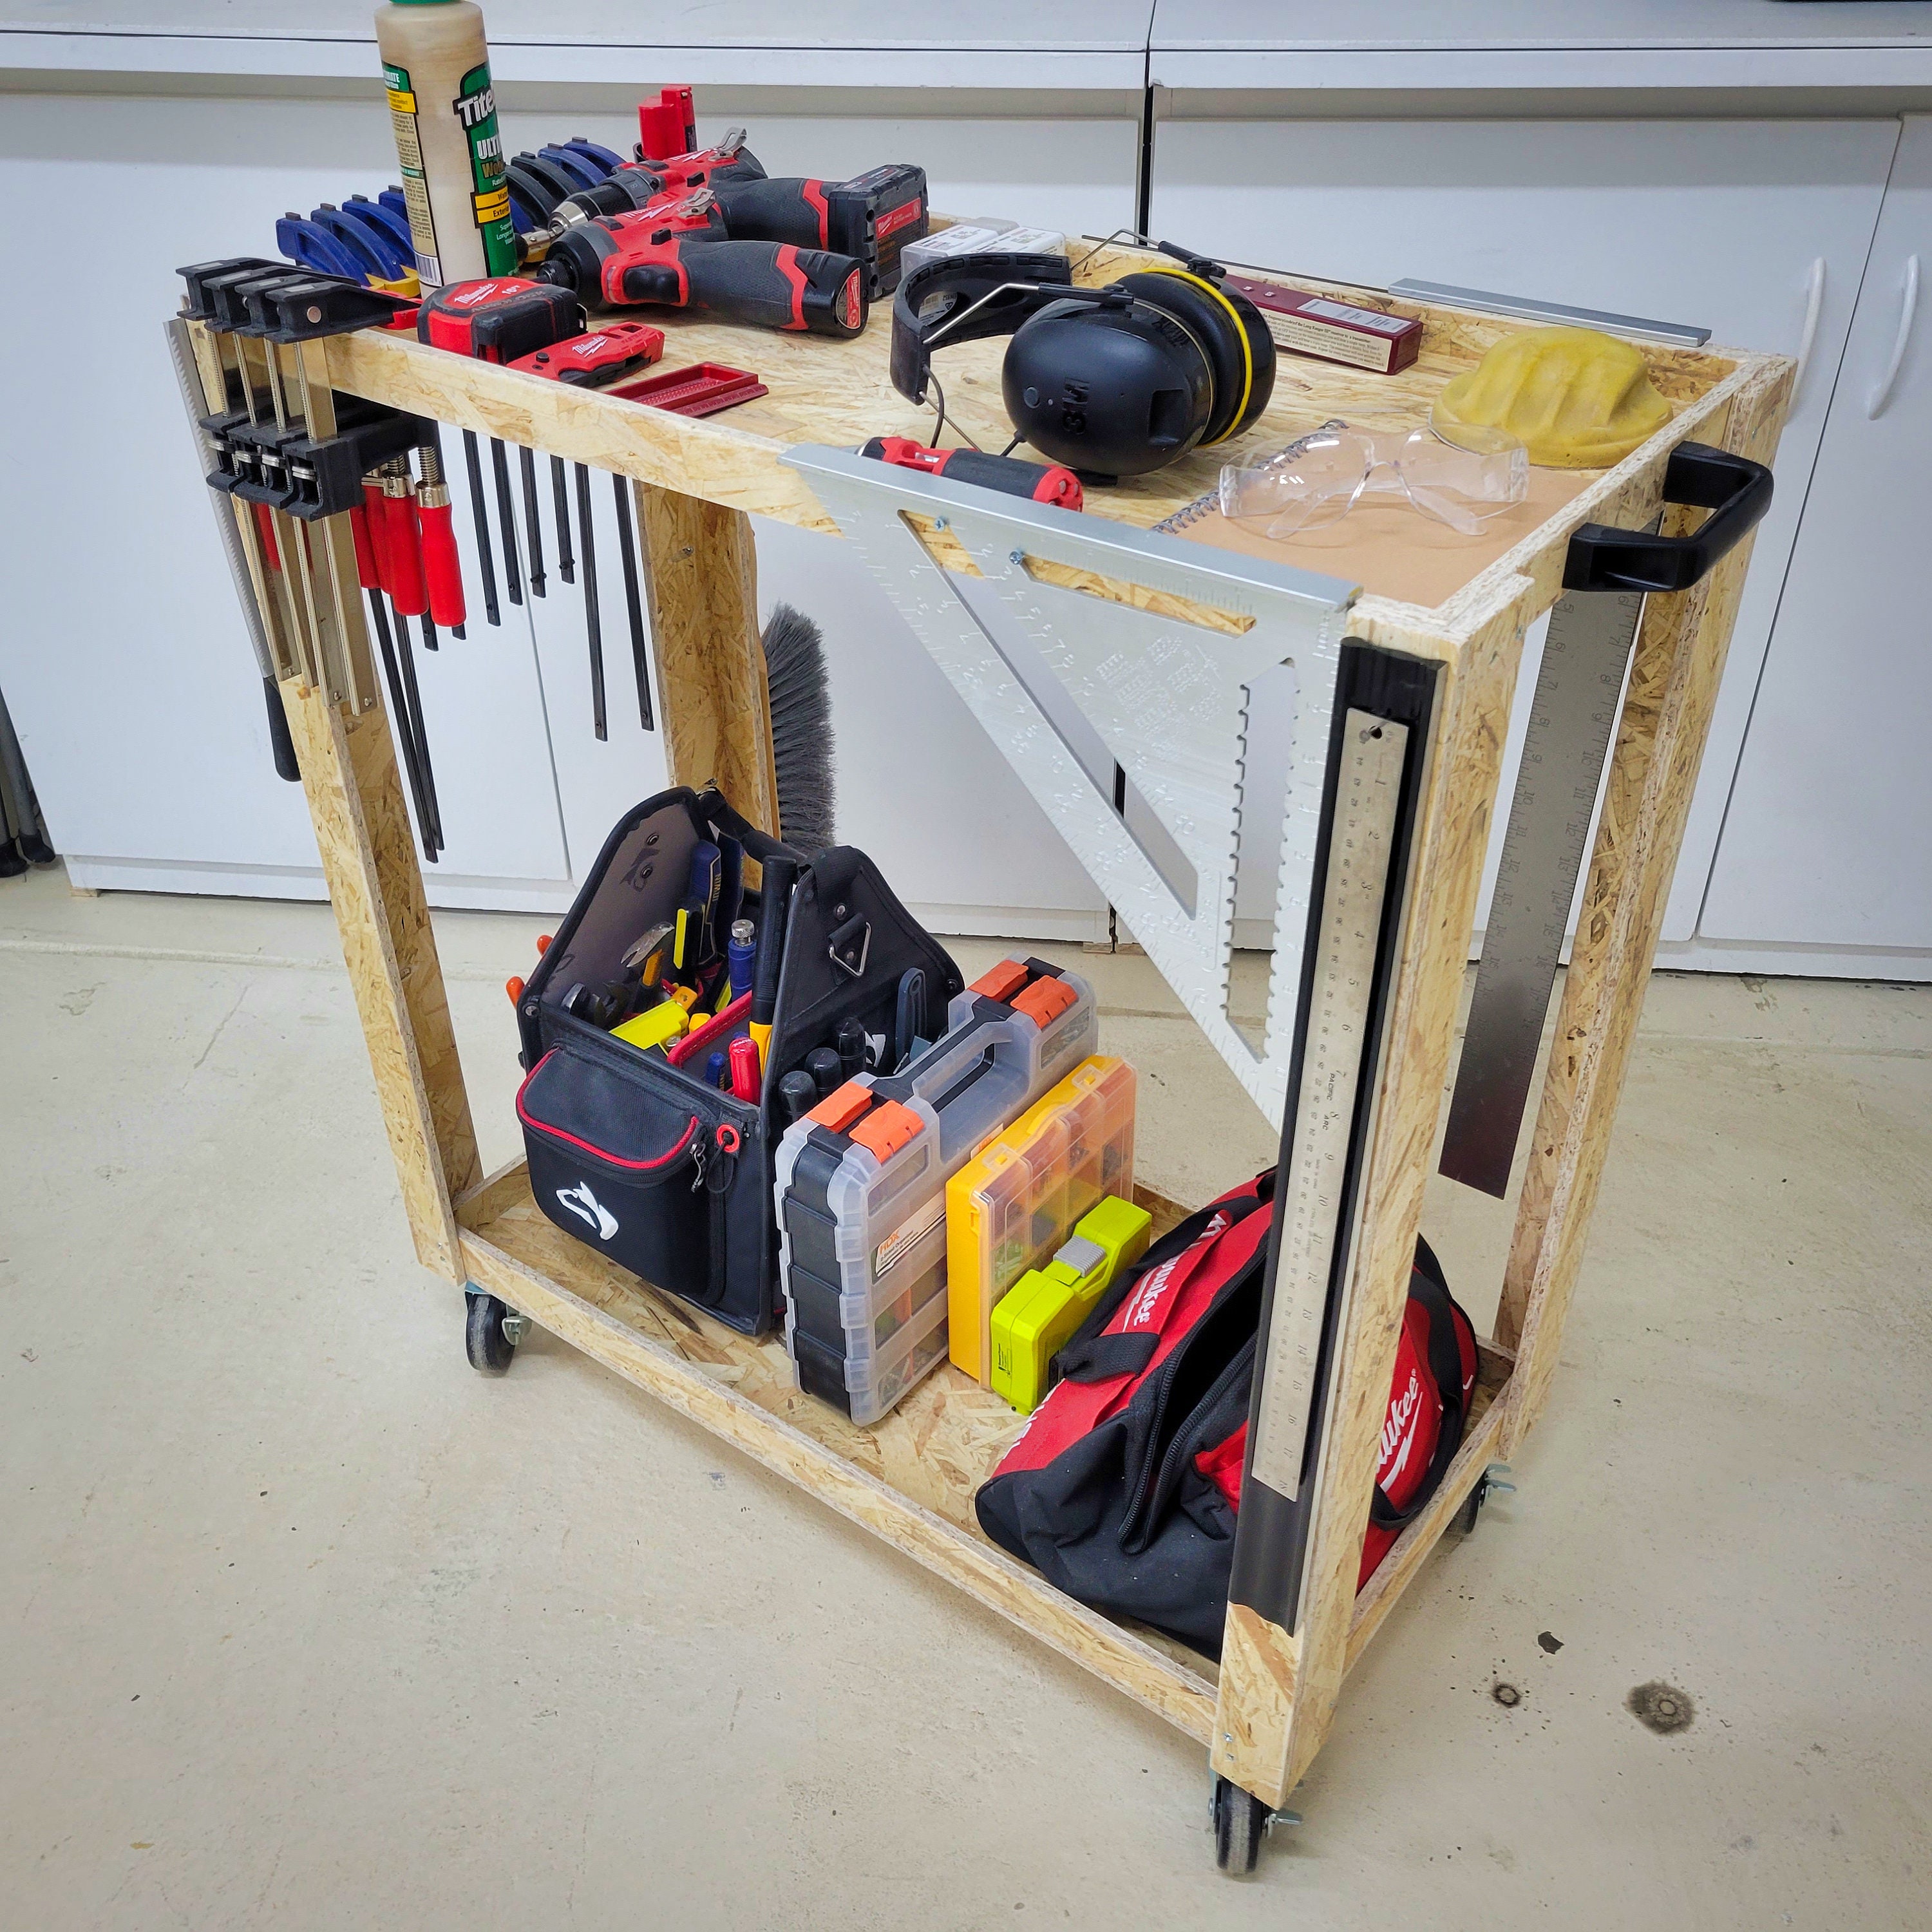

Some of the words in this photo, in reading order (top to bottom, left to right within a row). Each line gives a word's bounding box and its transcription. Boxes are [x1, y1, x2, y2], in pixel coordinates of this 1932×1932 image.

[458, 89, 495, 126] Tite
[454, 283, 495, 304] Milwaukee
[572, 336, 606, 355] Milwaukee
[1564, 603, 1575, 612] 5
[1555, 642, 1566, 650] 6
[1611, 636, 1621, 645] 7
[1600, 674, 1611, 683] 8
[1549, 681, 1558, 690] 7
[1531, 753, 1542, 762] 9
[1581, 750, 1594, 766] 10
[1523, 790, 1535, 805] 10
[1573, 787, 1586, 799] 11
[1368, 831, 1379, 840] 2
[1516, 825, 1528, 837] 11
[1566, 822, 1578, 837] 12
[1509, 858, 1520, 873] 12
[1557, 856, 1571, 871] 13
[1361, 882, 1372, 890] 3
[1341, 1024, 1352, 1032] 6
[1327, 1073, 1335, 1101] PACIFIC
[1330, 1111, 1340, 1119] 8
[1324, 1153, 1334, 1161] 9
[1318, 1195, 1329, 1207] 10
[880, 1230, 900, 1255] HDX
[1313, 1233, 1323, 1245] 11
[1133, 1213, 1227, 1326] Mwaukee
[1307, 1272, 1318, 1283] 12
[1302, 1309, 1312, 1321] 13
[1297, 1345, 1307, 1356] 14
[1293, 1380, 1302, 1392] 15
[1288, 1414, 1297, 1426] 16
[1283, 1448, 1293, 1459] 17
